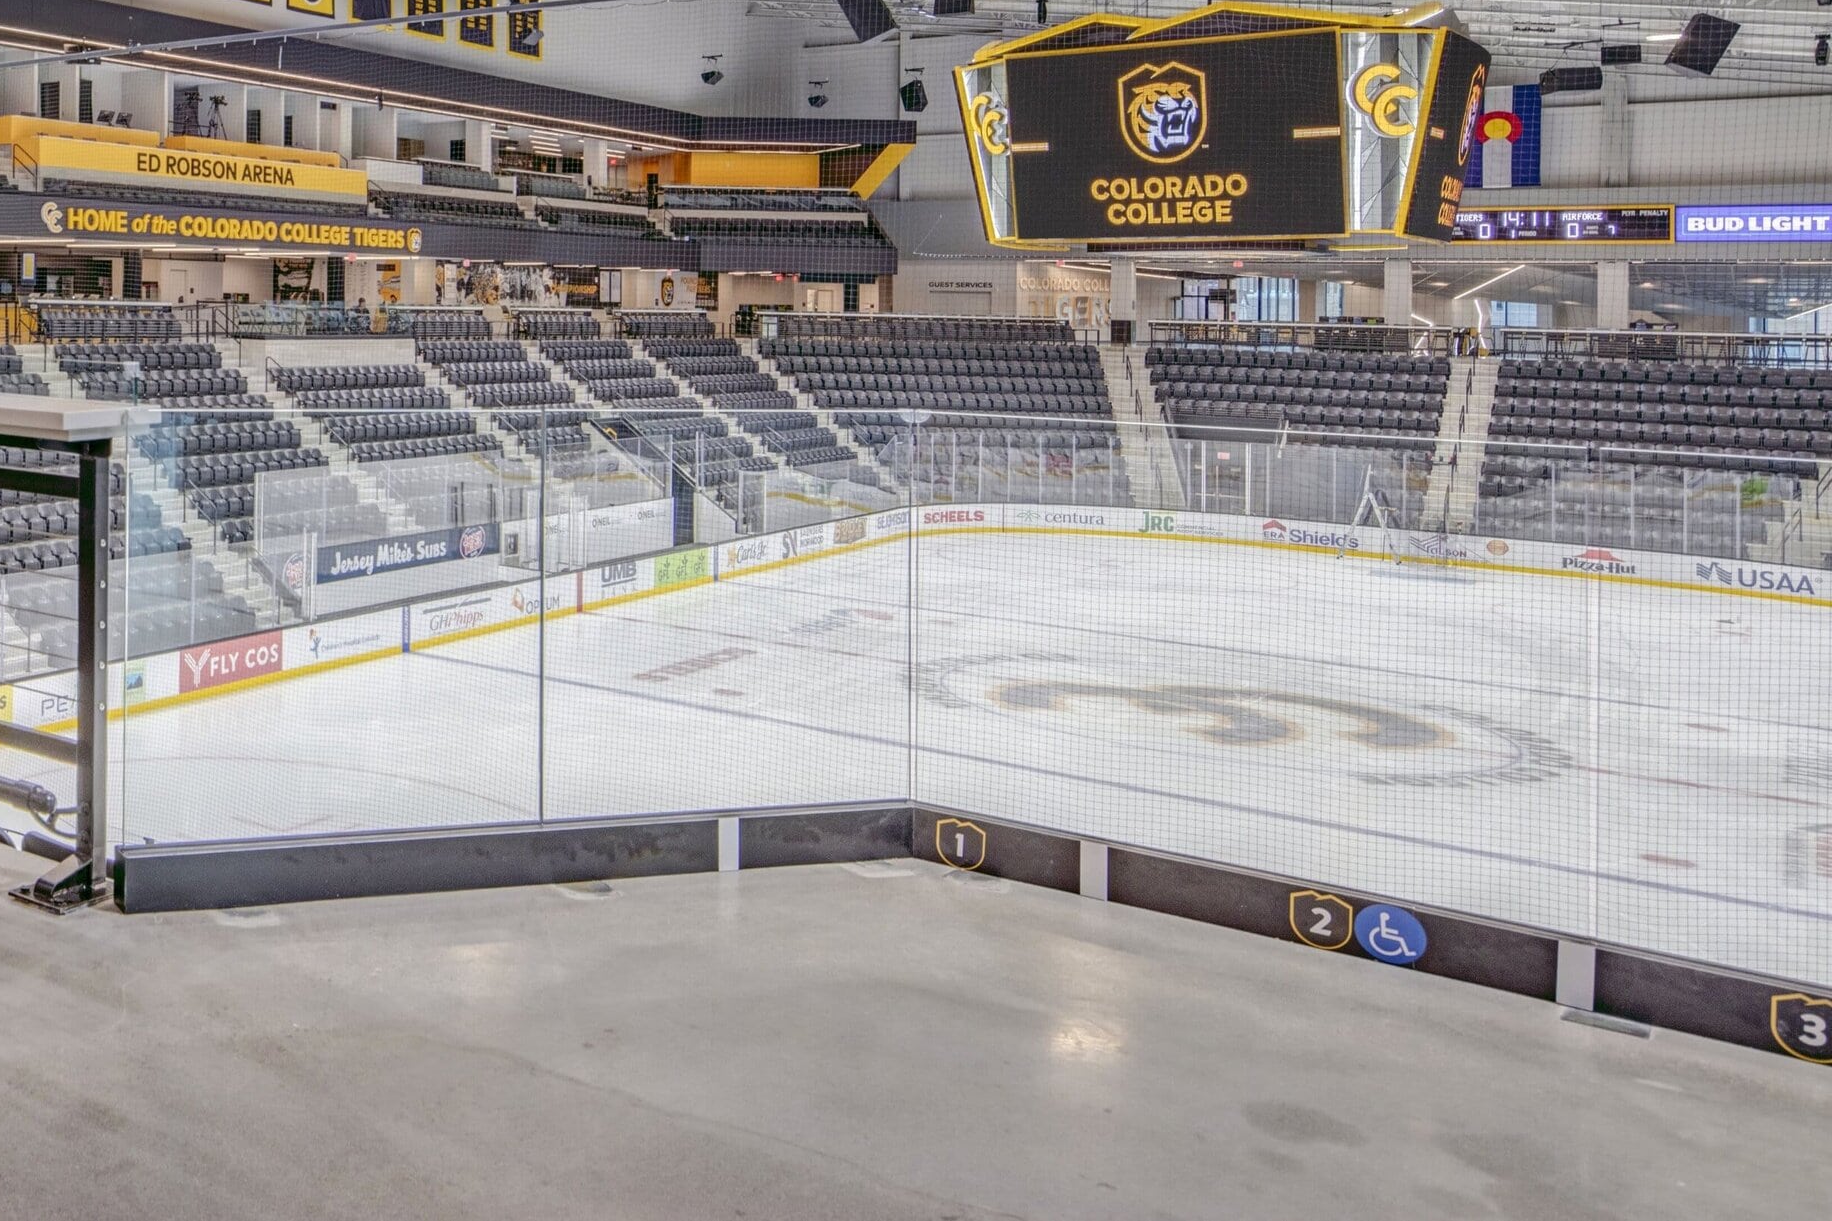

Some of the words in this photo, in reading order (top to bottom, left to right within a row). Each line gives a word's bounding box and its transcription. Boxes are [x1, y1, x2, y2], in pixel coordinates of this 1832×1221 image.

[137, 153, 161, 173] ED
[166, 155, 237, 181] ROBSON
[242, 164, 295, 186] ARENA
[1091, 173, 1248, 201] COLORADO
[1107, 200, 1233, 225] COLLEGE
[1456, 213, 1483, 222] TIGERS
[1503, 211, 1550, 227] 14:11
[1639, 209, 1668, 217] PENALTY
[67, 207, 128, 233] HOME
[131, 214, 152, 233] of
[151, 215, 177, 235] the
[179, 215, 278, 242] COLORADO
[279, 221, 351, 246] COLLEGE
[353, 226, 405, 250] TIGERS
[1479, 223, 1491, 239] 0
[1567, 222, 1579, 238] 0
[1687, 217, 1744, 231] BUD
[1748, 216, 1830, 232] LIGHT
[928, 281, 954, 289] GUEST
[955, 281, 994, 289] SERVICES
[1019, 278, 1081, 291] COLORADO
[1083, 280, 1110, 292] COLL
[923, 510, 985, 524] SCHEELS
[1044, 512, 1105, 525] centura
[1138, 511, 1175, 533] JRC
[1263, 531, 1286, 540] ERA
[1289, 529, 1359, 548] Shields
[331, 551, 374, 575] Jersey
[376, 542, 415, 567] Mike's
[1561, 556, 1604, 572] Pizza
[1604, 561, 1636, 575] Hut
[600, 561, 637, 583] UMB
[1737, 567, 1815, 595] USAA
[526, 595, 560, 615] OPUM
[210, 652, 239, 677] FLY
[245, 643, 279, 668] COS
[954, 832, 964, 858] 1
[1309, 907, 1332, 937] 2
[1798, 1013, 1827, 1047] 3
